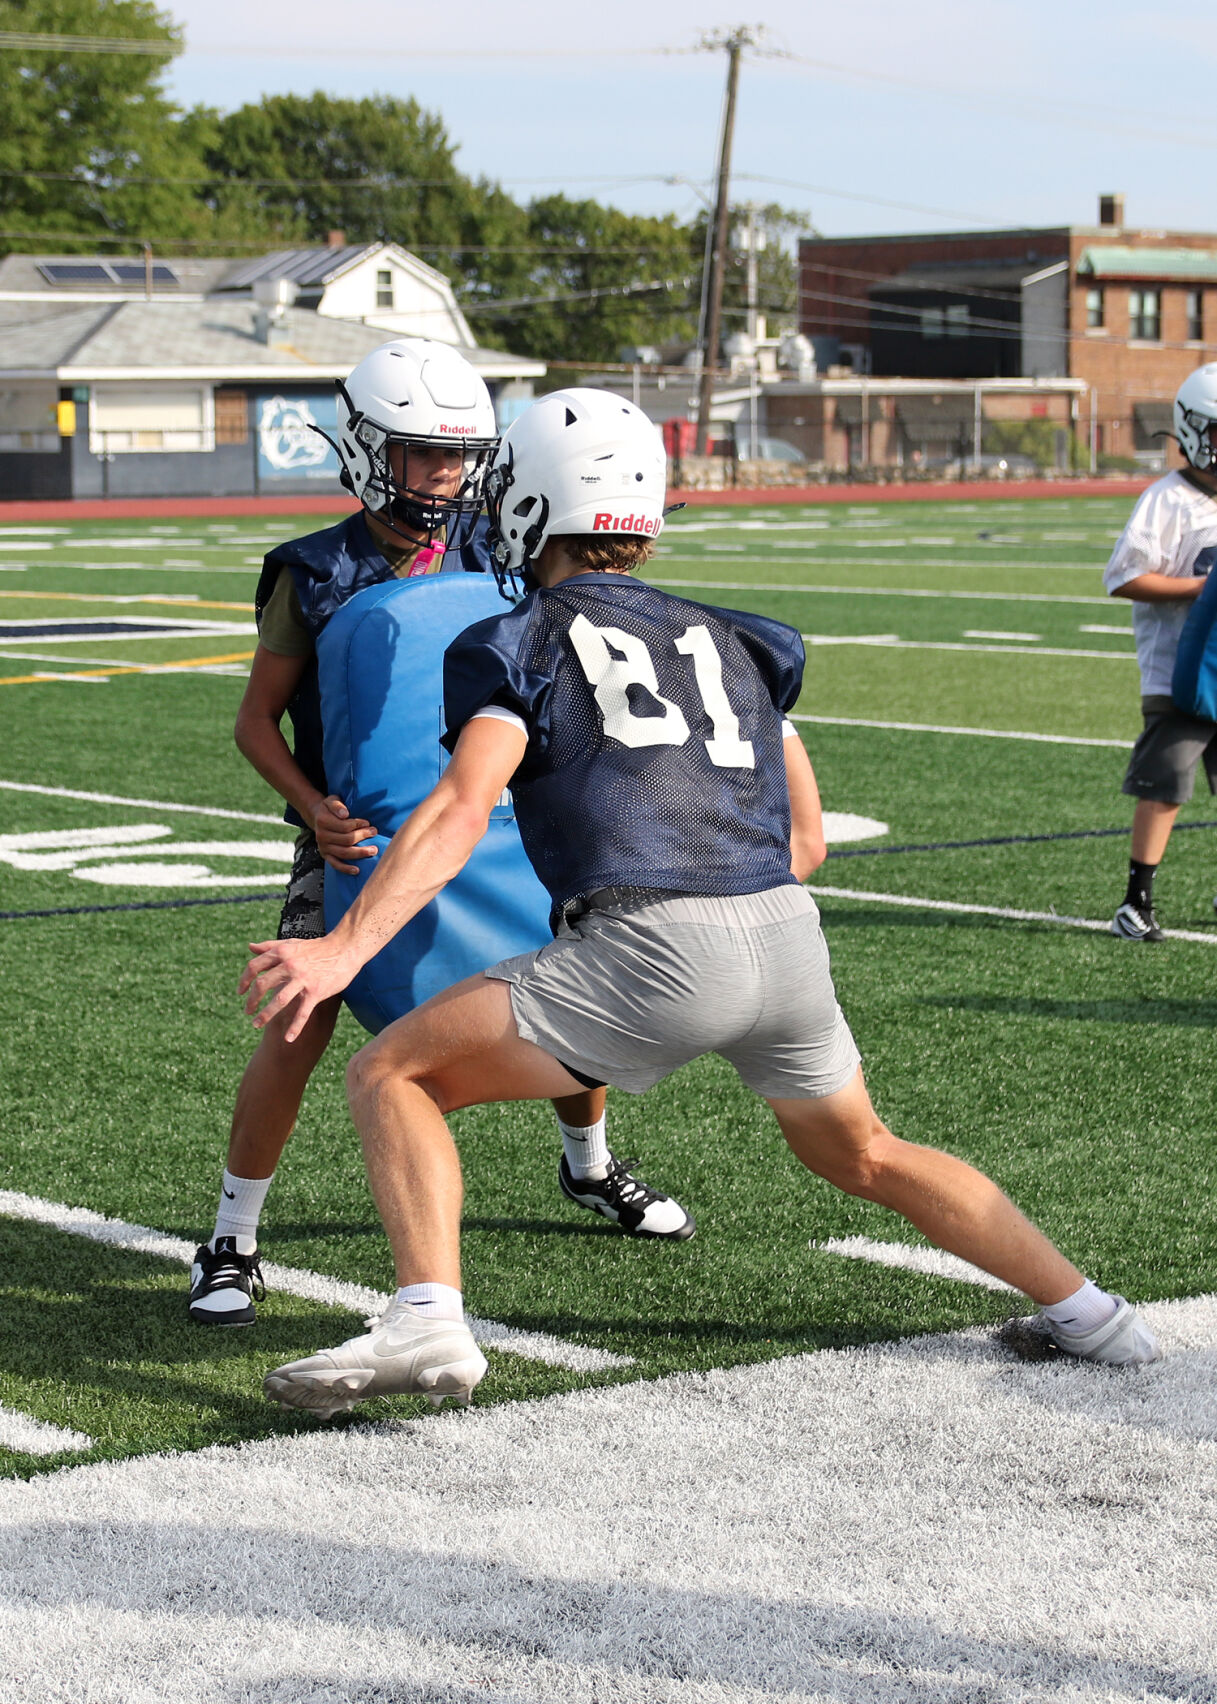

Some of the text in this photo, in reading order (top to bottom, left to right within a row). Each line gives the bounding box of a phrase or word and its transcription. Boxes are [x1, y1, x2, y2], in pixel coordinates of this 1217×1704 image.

[440, 424, 477, 434] Riddell
[592, 513, 661, 536] Riddell
[568, 613, 755, 769] 81
